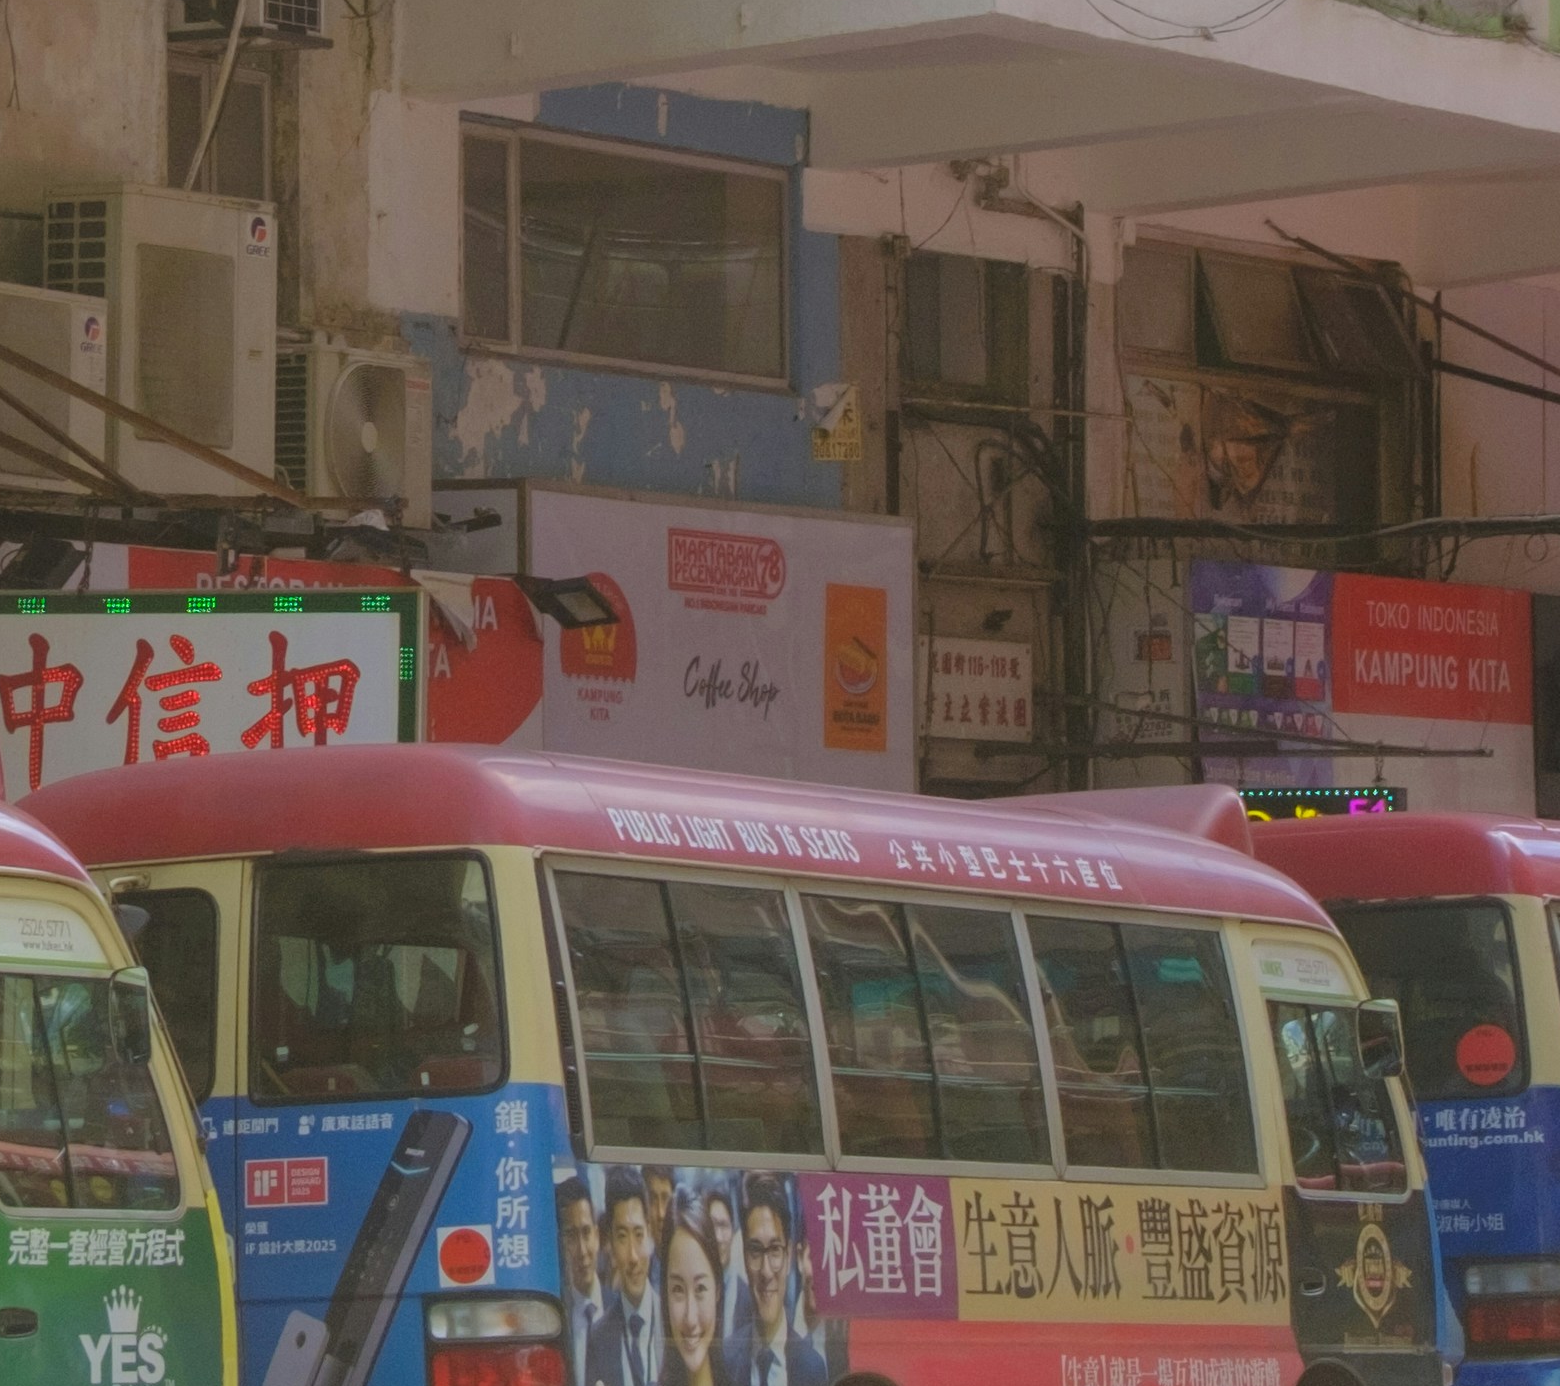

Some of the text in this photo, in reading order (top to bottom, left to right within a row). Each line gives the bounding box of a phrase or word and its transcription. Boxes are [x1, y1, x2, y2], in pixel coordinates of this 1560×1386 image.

[1366, 600, 1499, 638] TOKO INDONESIA
[684, 656, 733, 709] Coffee
[737, 660, 779, 721] Shop
[1355, 648, 1511, 694] KAMPUNG KITA
[606, 807, 861, 863] PUBLIC LIGHT BUS 16 SEATS
[888, 838, 1123, 892] 公共小型巴士十六座位
[817, 1183, 945, 1300] 私董會
[79, 1333, 167, 1385] YES
